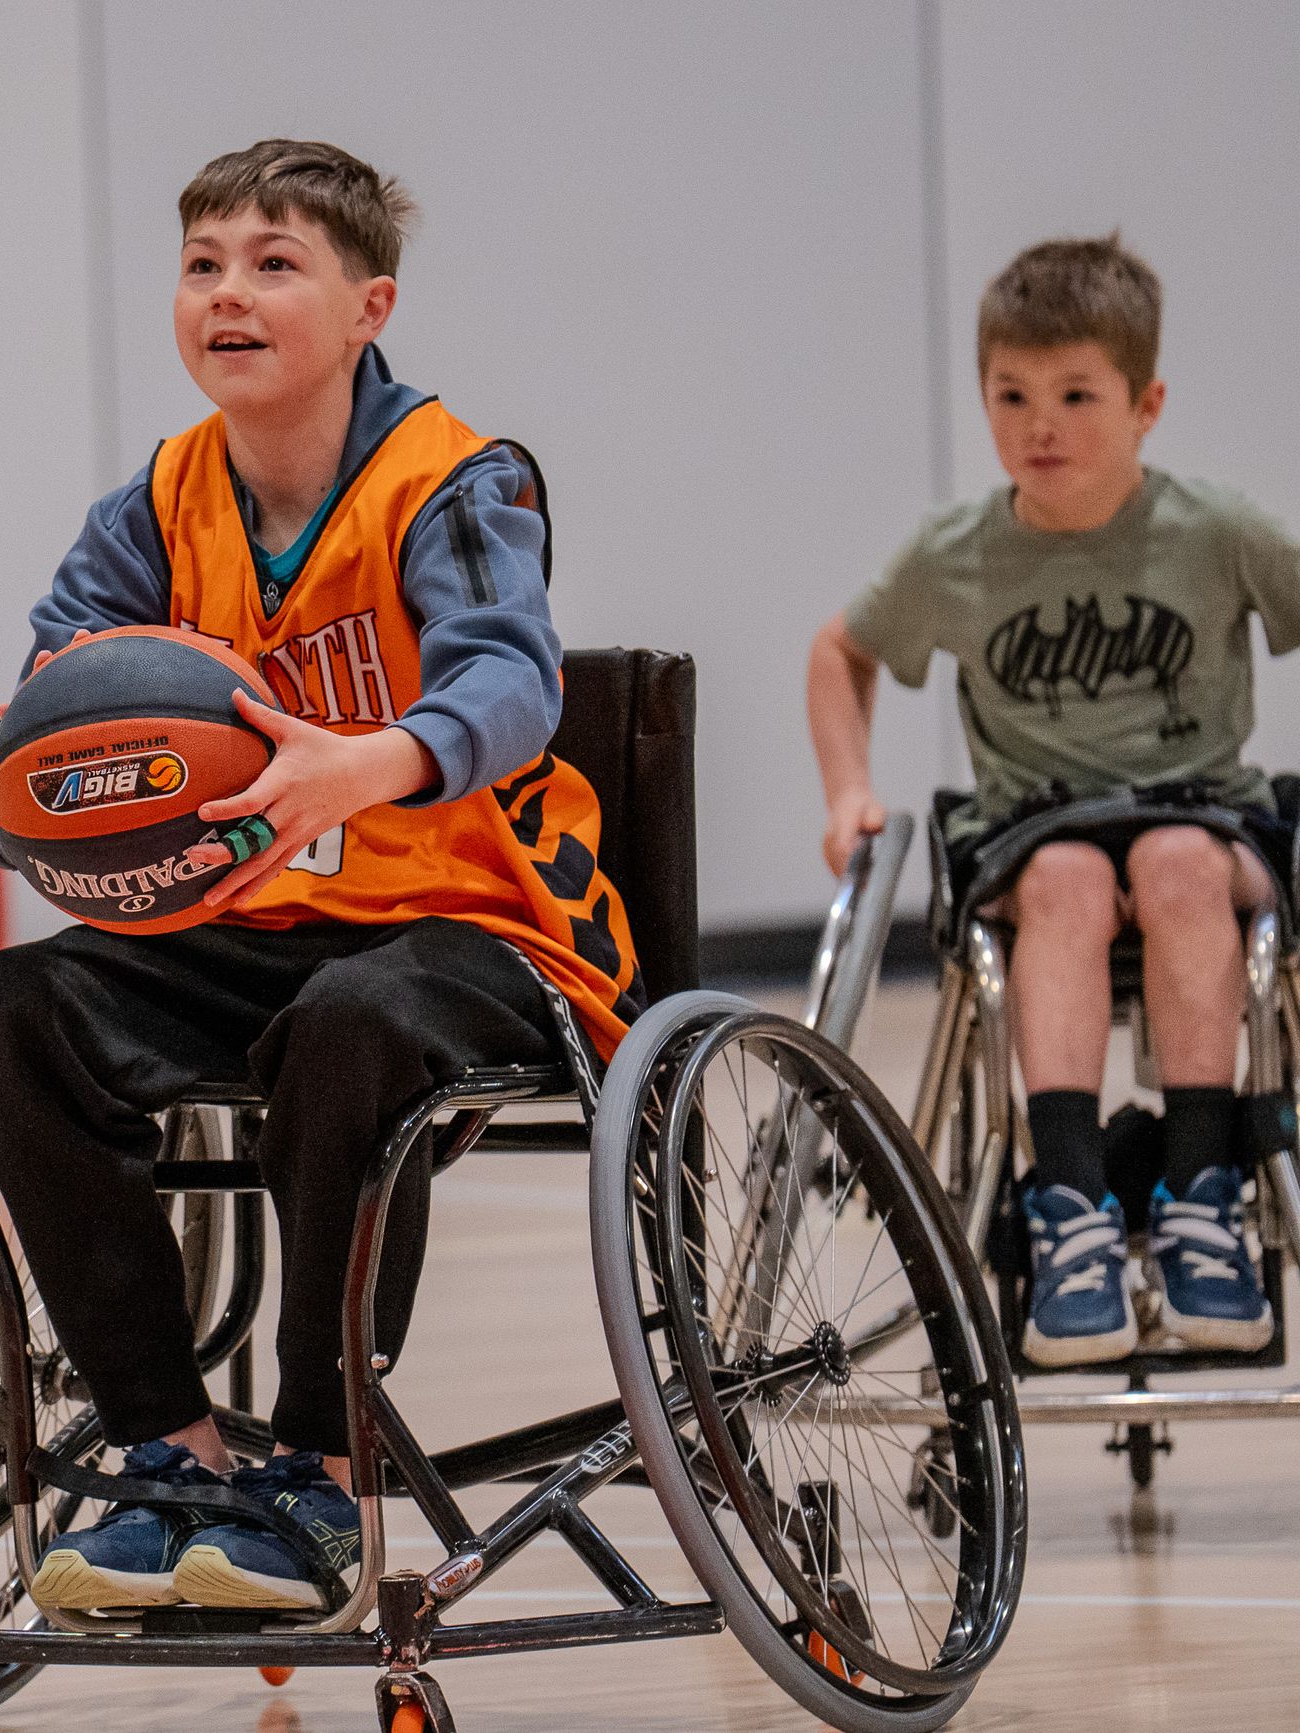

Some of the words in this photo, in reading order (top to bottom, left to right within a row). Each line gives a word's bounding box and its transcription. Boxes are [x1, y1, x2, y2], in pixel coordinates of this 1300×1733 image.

[110, 736, 169, 753] OFFICIAL
[67, 746, 105, 761] GAME
[37, 755, 63, 767] BALL
[88, 762, 140, 776] BASKETBALL
